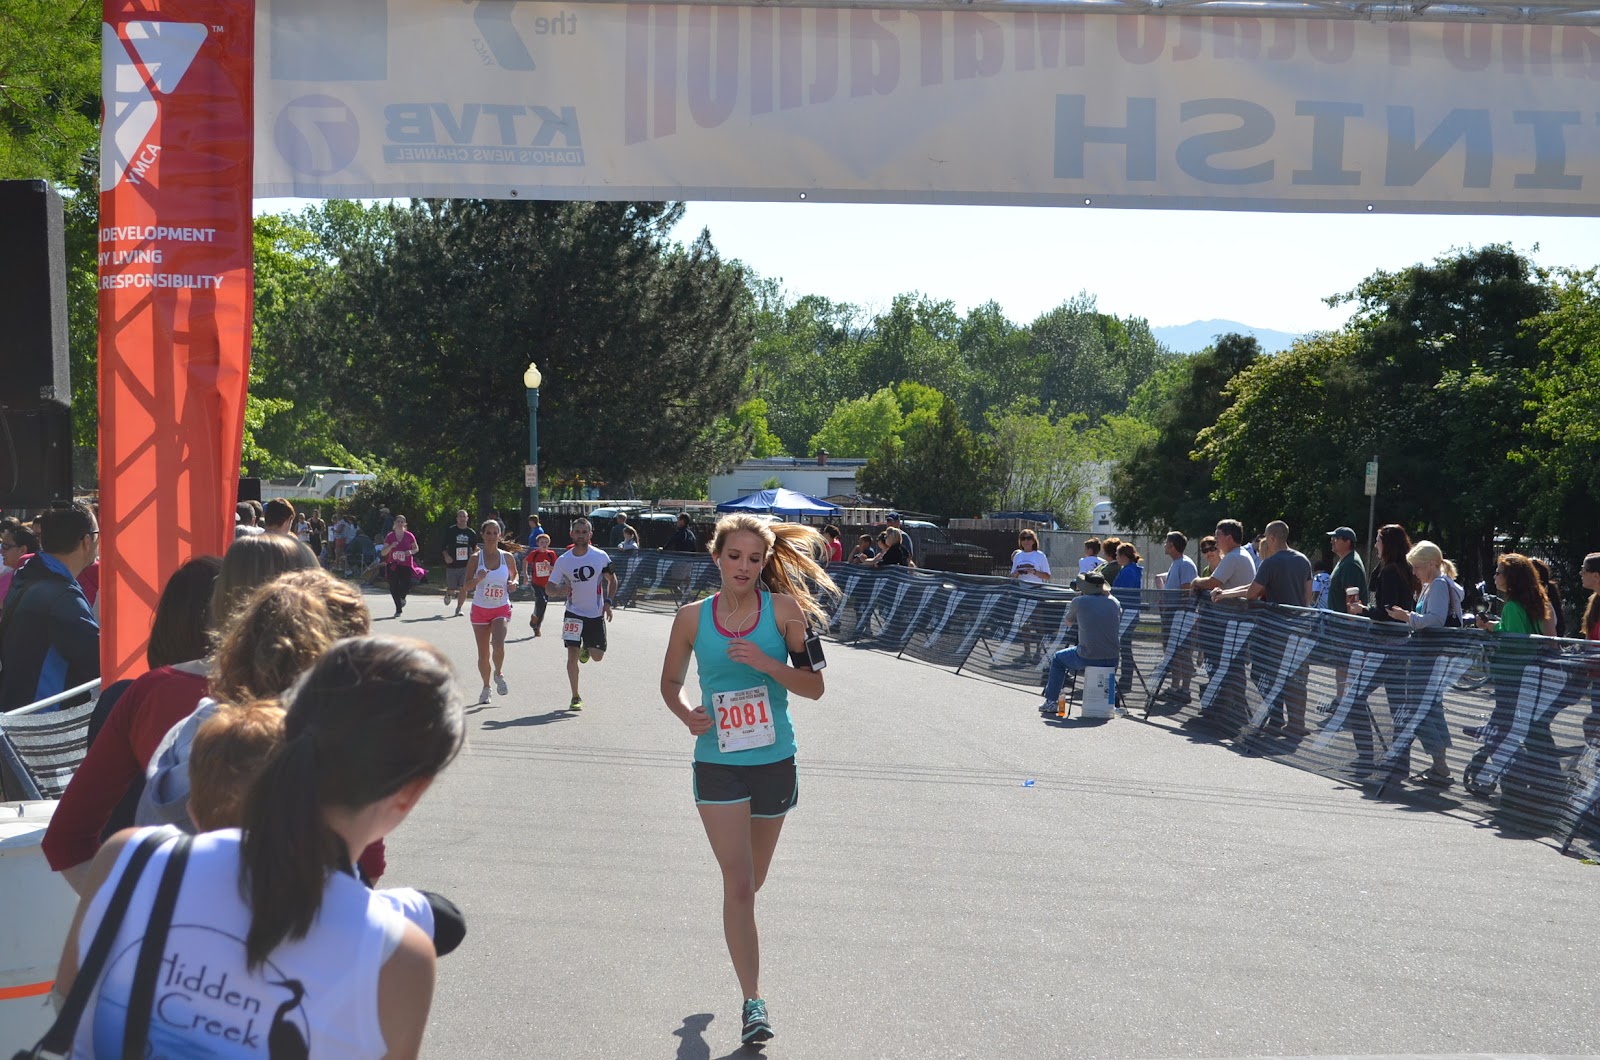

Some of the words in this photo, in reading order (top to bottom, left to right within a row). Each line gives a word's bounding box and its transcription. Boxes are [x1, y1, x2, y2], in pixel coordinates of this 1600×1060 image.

[125, 143, 162, 186] YMCA
[102, 226, 216, 242] DEVELOPMENT
[112, 249, 163, 265] LIVING
[102, 273, 224, 289] RESPONSIBILITY
[484, 587, 504, 598] 2165
[564, 622, 580, 633] 995
[717, 700, 769, 730] 2081
[156, 991, 260, 1049] Creek
